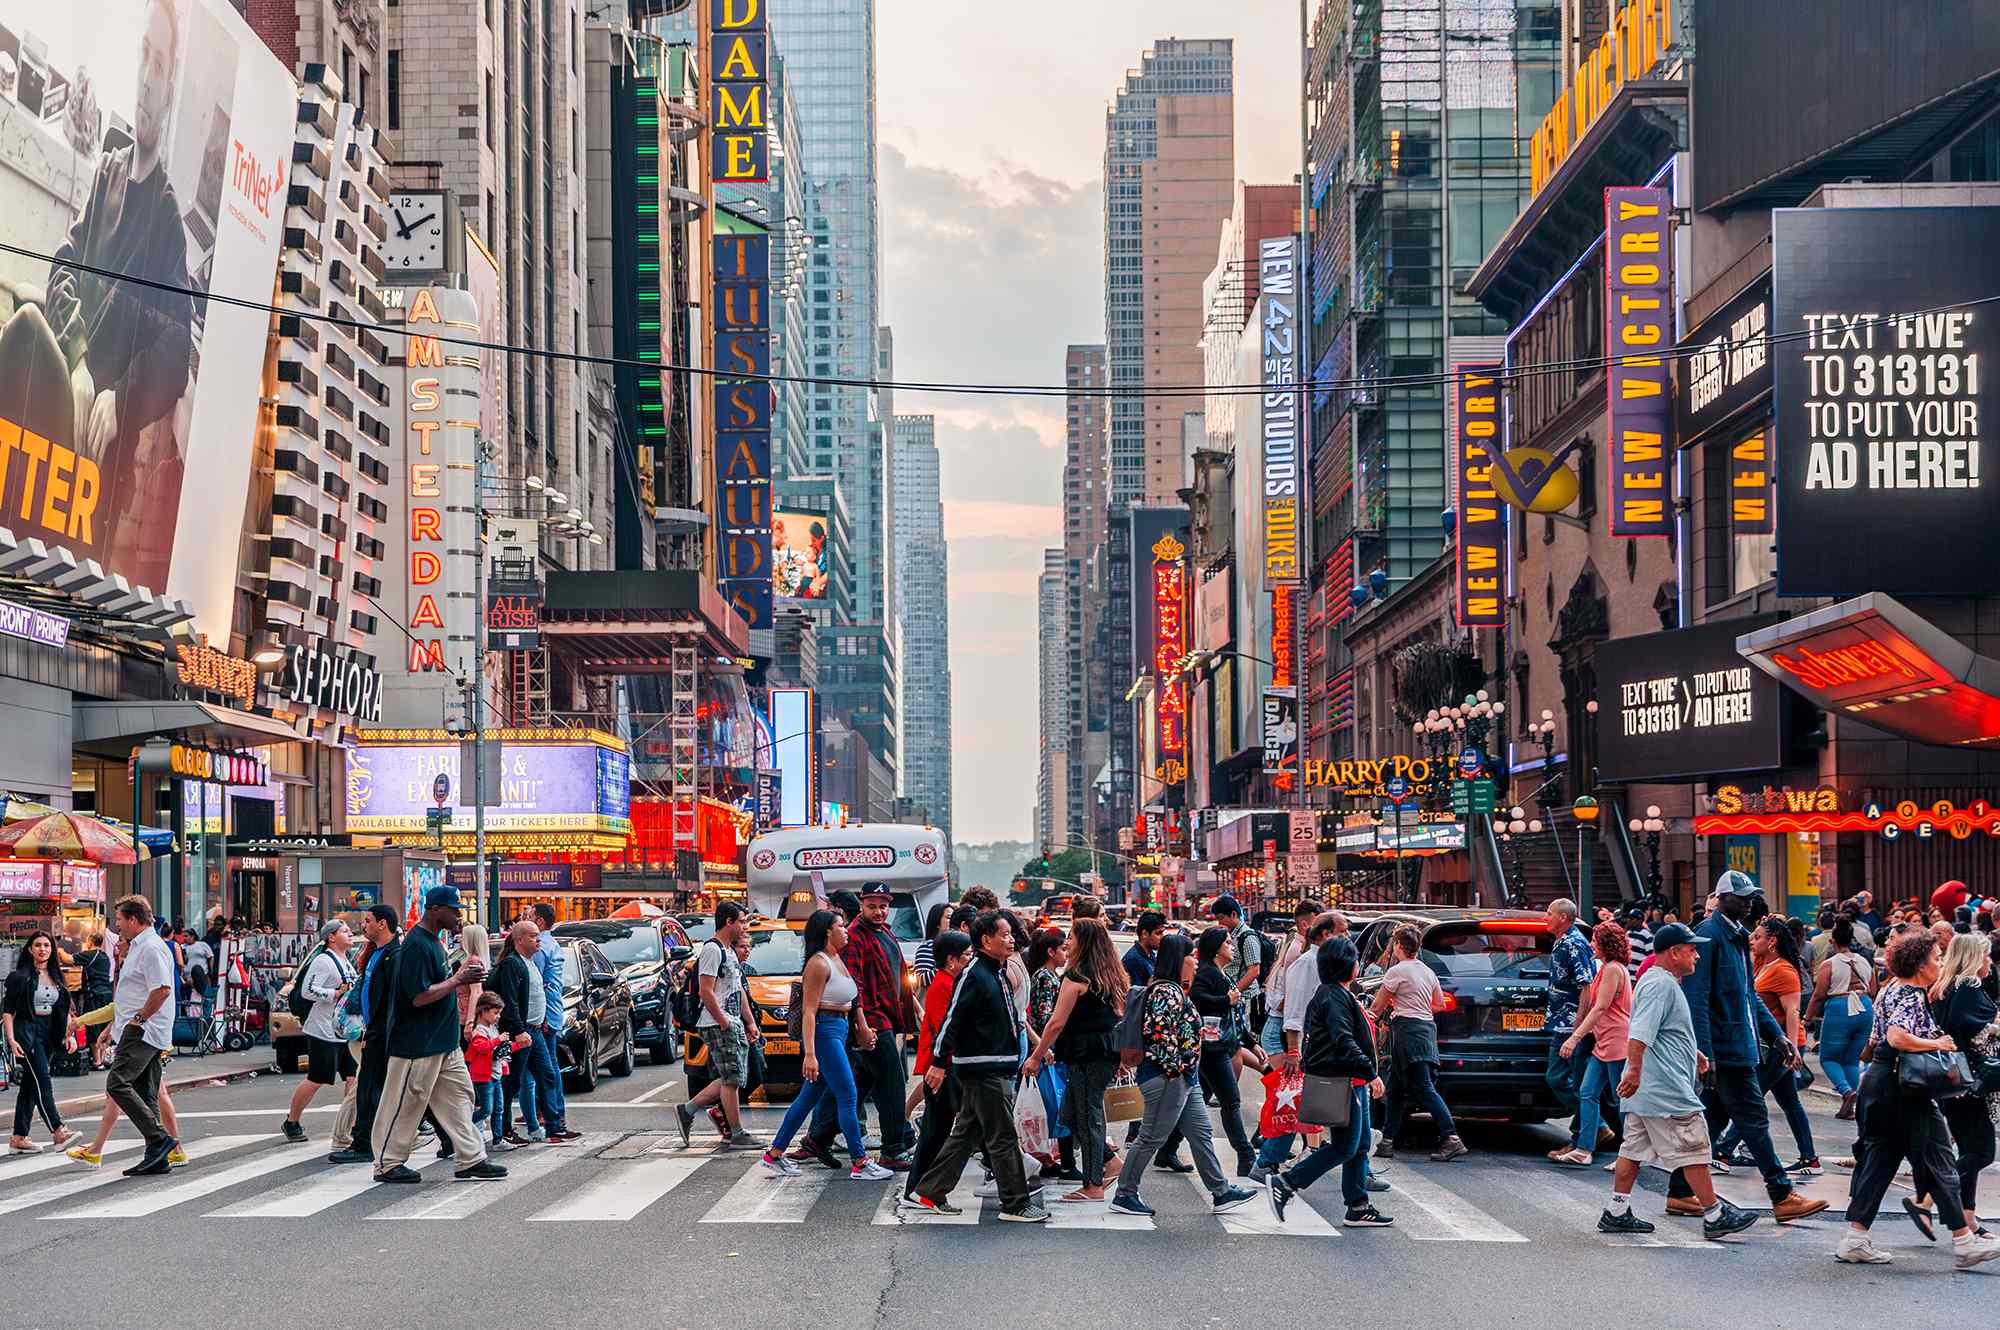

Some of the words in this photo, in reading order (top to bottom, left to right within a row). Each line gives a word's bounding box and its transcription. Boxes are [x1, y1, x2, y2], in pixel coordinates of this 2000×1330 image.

[716, 0, 764, 178] DAME
[233, 138, 270, 219] TriNet
[400, 197, 411, 208] 12
[402, 255, 410, 267] 6
[1262, 240, 1294, 295] NEW
[1619, 201, 1662, 399] VICTORY
[1264, 298, 1293, 356] 42
[1802, 314, 1879, 350] TEXT
[1803, 355, 1845, 397] TO
[1853, 353, 1978, 396] 313131
[723, 237, 763, 627] TUSSAUDS
[1804, 402, 1840, 438] TO
[1847, 401, 1899, 437] PUT
[1905, 400, 1978, 437] YOUR
[1265, 390, 1296, 495] STUDIOS
[1465, 373, 1497, 524] VICTORY
[408, 289, 447, 674] AMSTERDAM
[1620, 430, 1663, 523] NEW
[1805, 442, 1858, 490] AD
[1868, 440, 1981, 489] HERE!
[1266, 508, 1297, 570] DUKE
[1467, 545, 1498, 616] NEW
[0, 604, 32, 634] RONT
[35, 615, 67, 643] PRIME
[489, 612, 537, 628] RISE
[492, 597, 535, 613] ALL
[1156, 568, 1184, 751] REGAL
[1771, 639, 1918, 689] Subway
[290, 644, 385, 723] SEPHORA
[1621, 681, 1647, 707] TEXT
[1693, 674, 1707, 696] TO
[1707, 670, 1726, 695] PUT
[1726, 667, 1751, 693] YOUR
[1264, 700, 1281, 761] DANCE
[1622, 708, 1637, 736] TO
[1637, 703, 1681, 736] 313131
[1694, 697, 1713, 728] AD
[1713, 692, 1752, 726] HERE!
[513, 753, 528, 777] &
[1304, 758, 1389, 786] HARRY
[483, 816, 506, 828] OUR
[510, 816, 556, 828] TICKETS
[559, 815, 588, 827] HERE
[759, 779, 771, 822] DANCE
[1866, 804, 1881, 819] A
[1901, 804, 1914, 818] Q
[1938, 803, 1951, 818] R
[1975, 802, 1984, 816] 1
[1293, 827, 1314, 840] 25
[1883, 823, 1898, 838] C
[1919, 823, 1933, 837] E
[1954, 821, 1968, 835] W
[1991, 821, 2000, 836] 2
[802, 849, 890, 866] PATERSON
